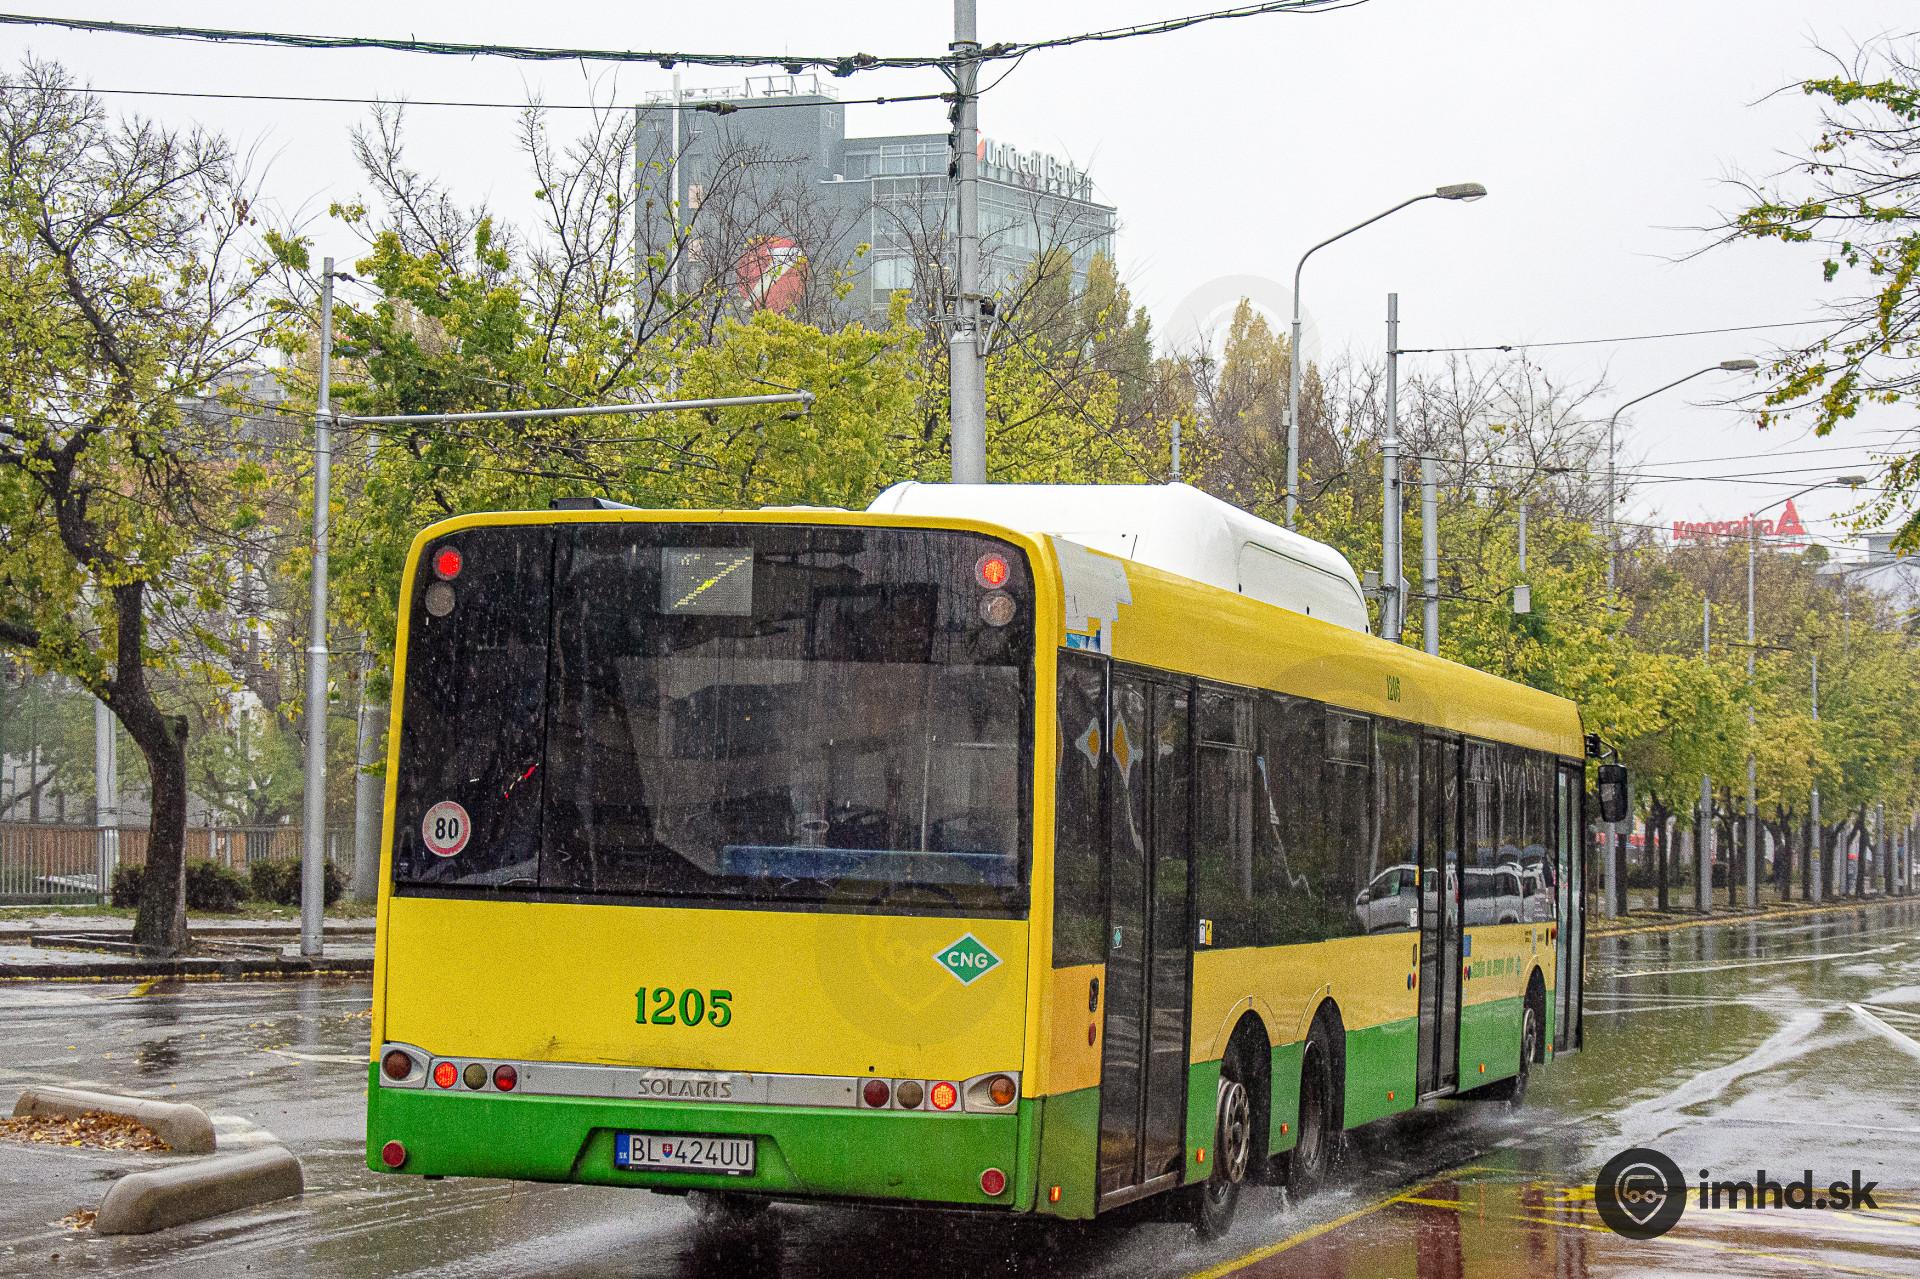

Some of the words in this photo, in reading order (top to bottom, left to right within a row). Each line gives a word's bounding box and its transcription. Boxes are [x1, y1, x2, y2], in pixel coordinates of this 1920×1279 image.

[985, 138, 1044, 178] UniCredit
[1046, 153, 1086, 187] Bank
[435, 817, 459, 840] 80
[947, 950, 988, 969] CNG
[635, 986, 732, 1028] 1205
[638, 1078, 732, 1098] SOLARIS
[619, 1151, 628, 1160] SK
[632, 1137, 660, 1163] BL
[674, 1139, 749, 1167] 424UU
